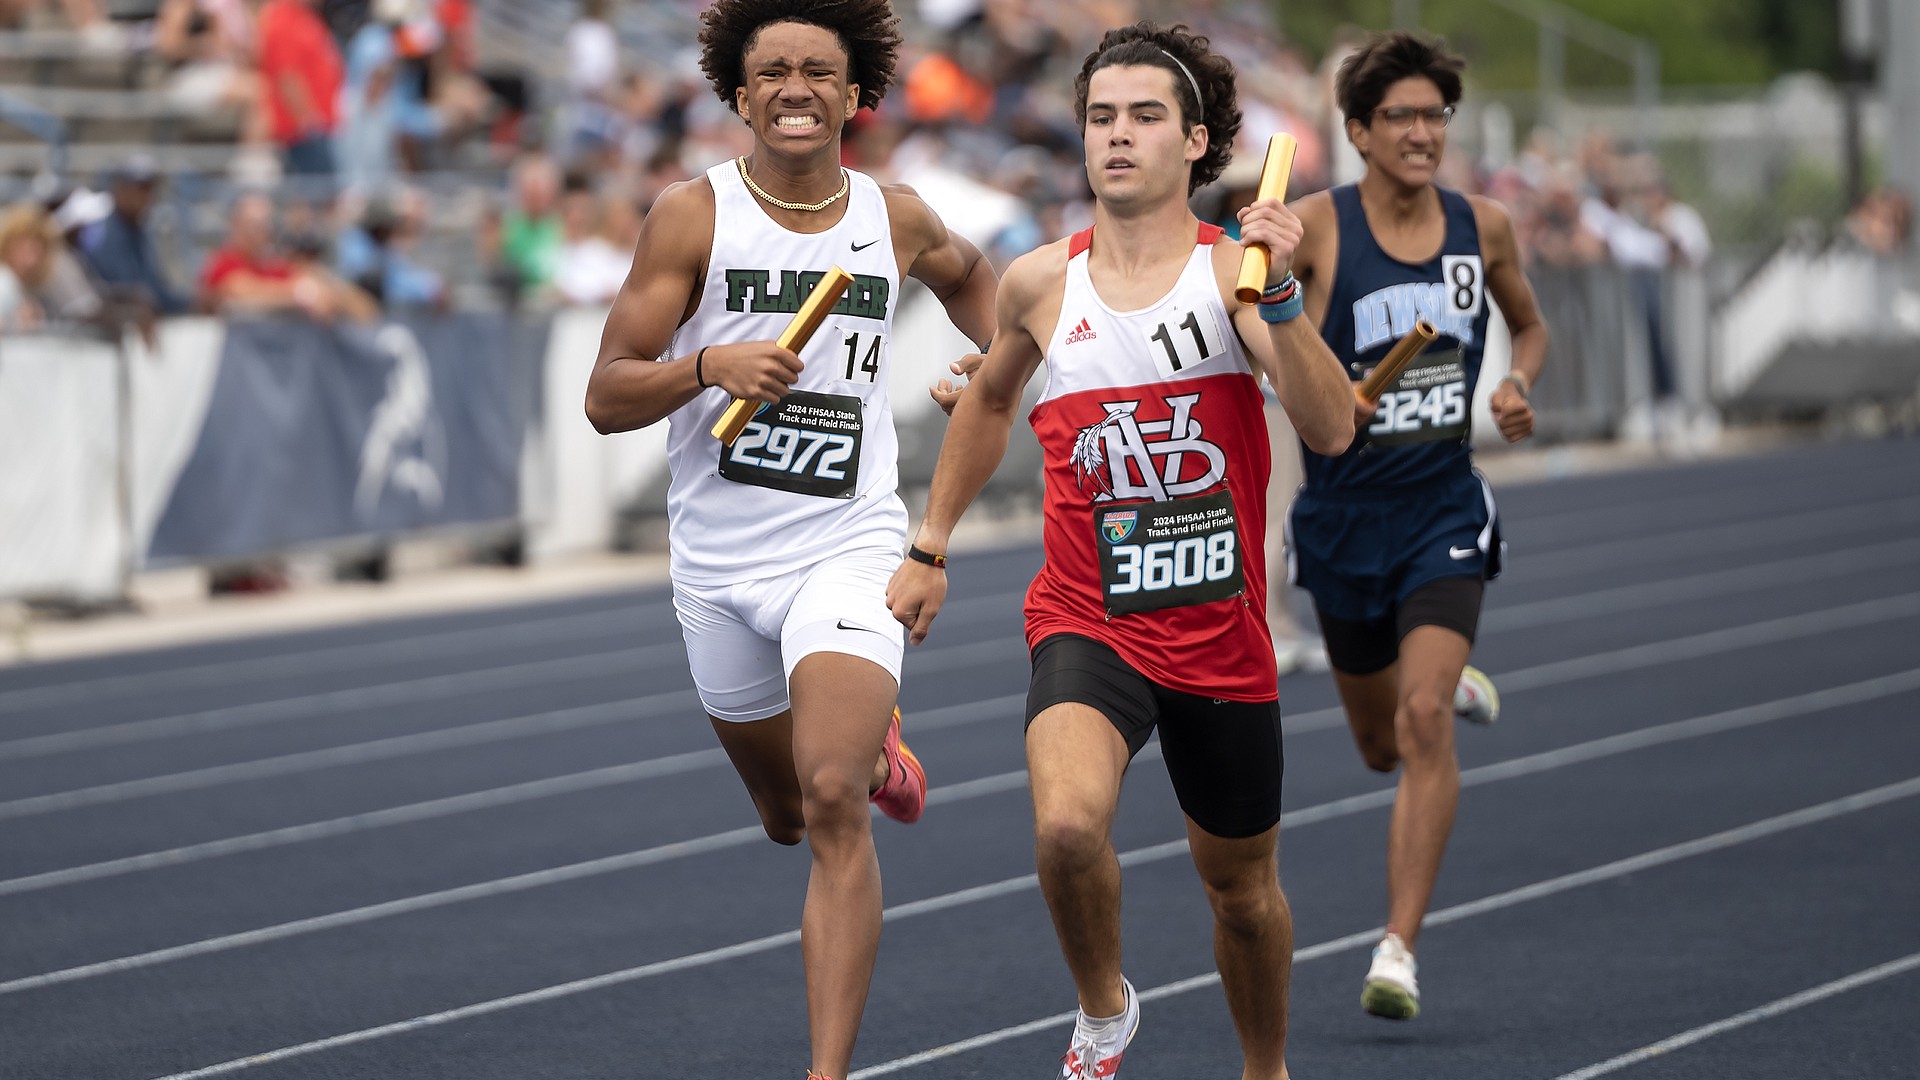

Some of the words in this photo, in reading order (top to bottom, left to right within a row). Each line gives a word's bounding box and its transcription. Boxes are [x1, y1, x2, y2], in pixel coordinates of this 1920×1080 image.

[725, 269, 889, 320] FLAER
[1453, 263, 1475, 310] 8
[1065, 332, 1097, 345] adidas
[1150, 310, 1209, 372] 11
[1353, 282, 1474, 354] NEWSO
[844, 332, 882, 382] 14
[778, 412, 800, 423] Track
[800, 417, 817, 425] and
[818, 418, 838, 429] Field
[839, 420, 861, 431] Finals
[786, 404, 807, 414] 2024
[808, 407, 835, 418] FHSAA
[836, 410, 856, 420] State
[1368, 381, 1465, 434] 3245
[729, 424, 855, 480] 2972
[1146, 526, 1171, 537] Track
[1172, 525, 1189, 535] and
[1190, 520, 1211, 532] Field
[1212, 515, 1234, 528] Finals
[1152, 516, 1175, 526] 2024
[1176, 512, 1205, 524] FHSAA
[1206, 507, 1227, 518] State
[1109, 530, 1235, 594] 3608
